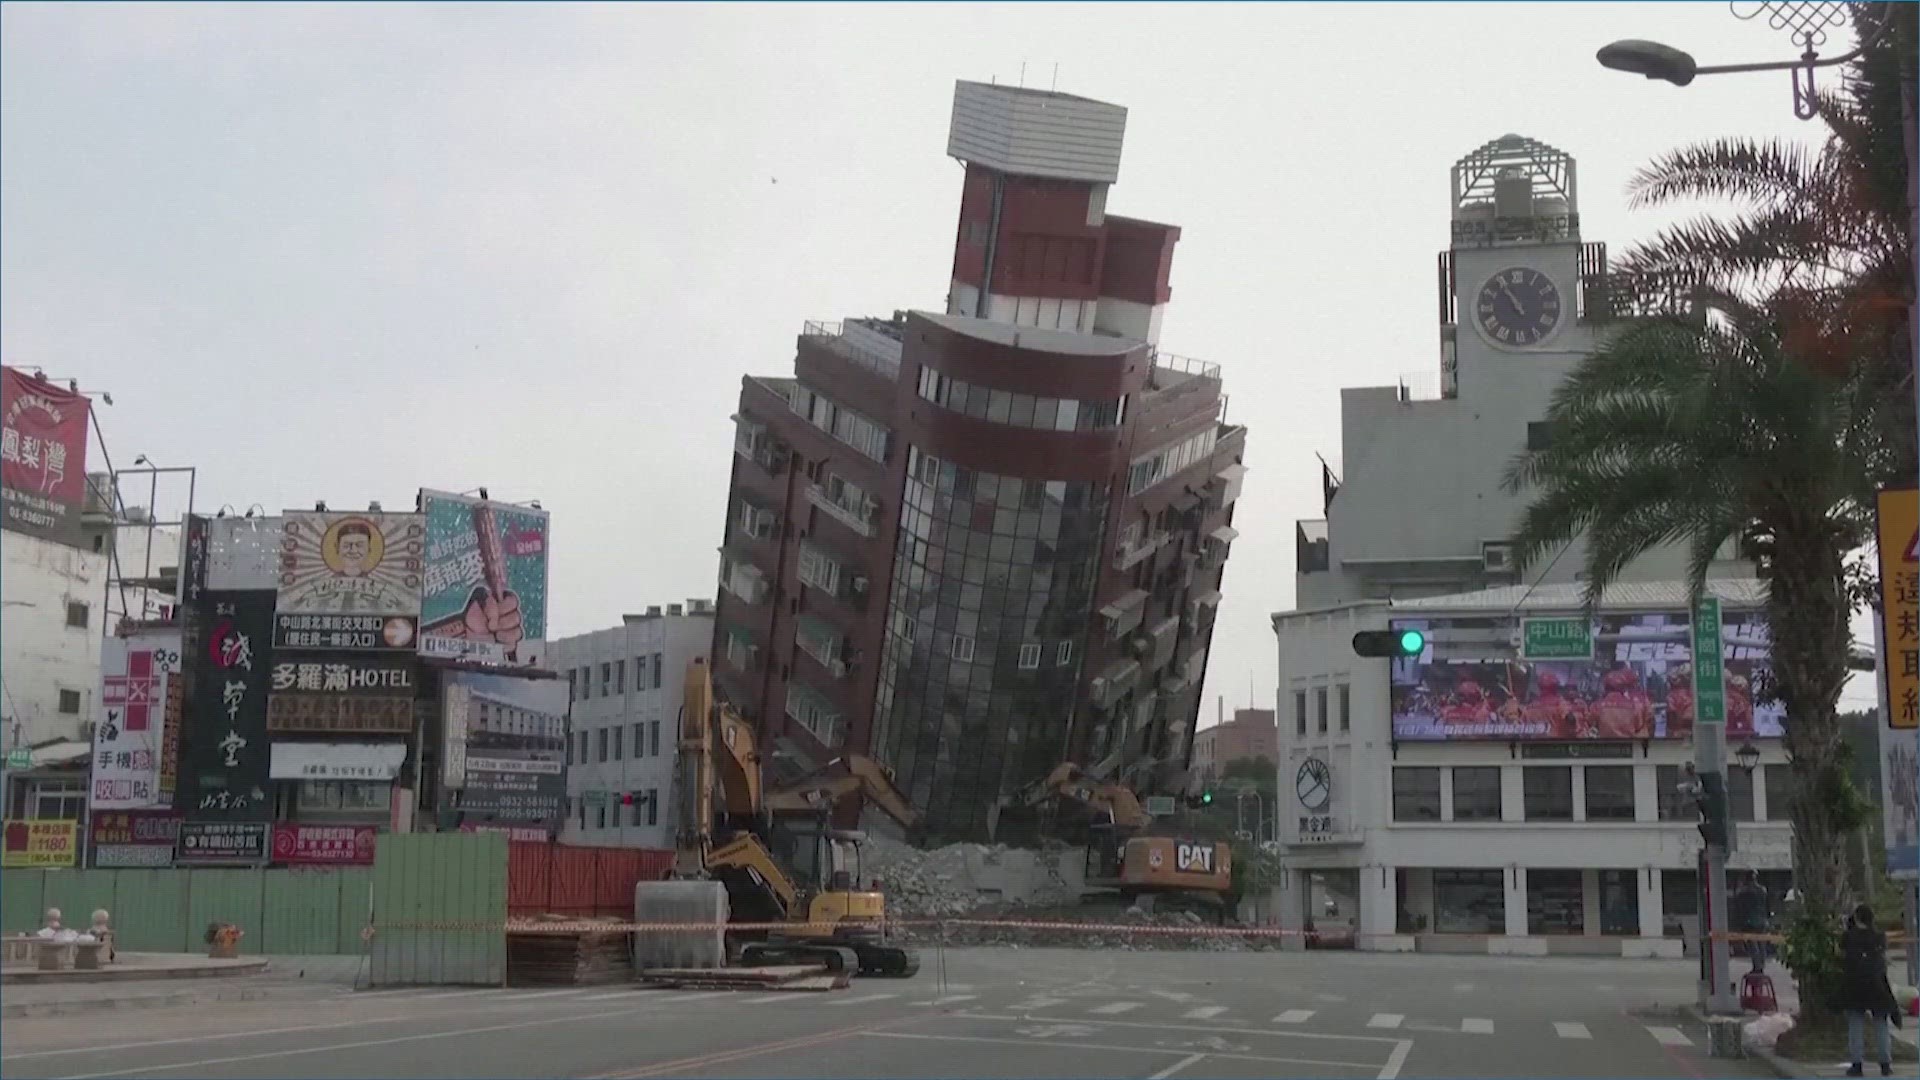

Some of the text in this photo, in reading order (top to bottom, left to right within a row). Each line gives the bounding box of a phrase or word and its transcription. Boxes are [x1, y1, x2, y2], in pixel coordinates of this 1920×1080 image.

[1530, 621, 1584, 641] 中山路
[271, 662, 411, 691] 多羅滿 HOTEL
[1177, 844, 1213, 872] CAT
